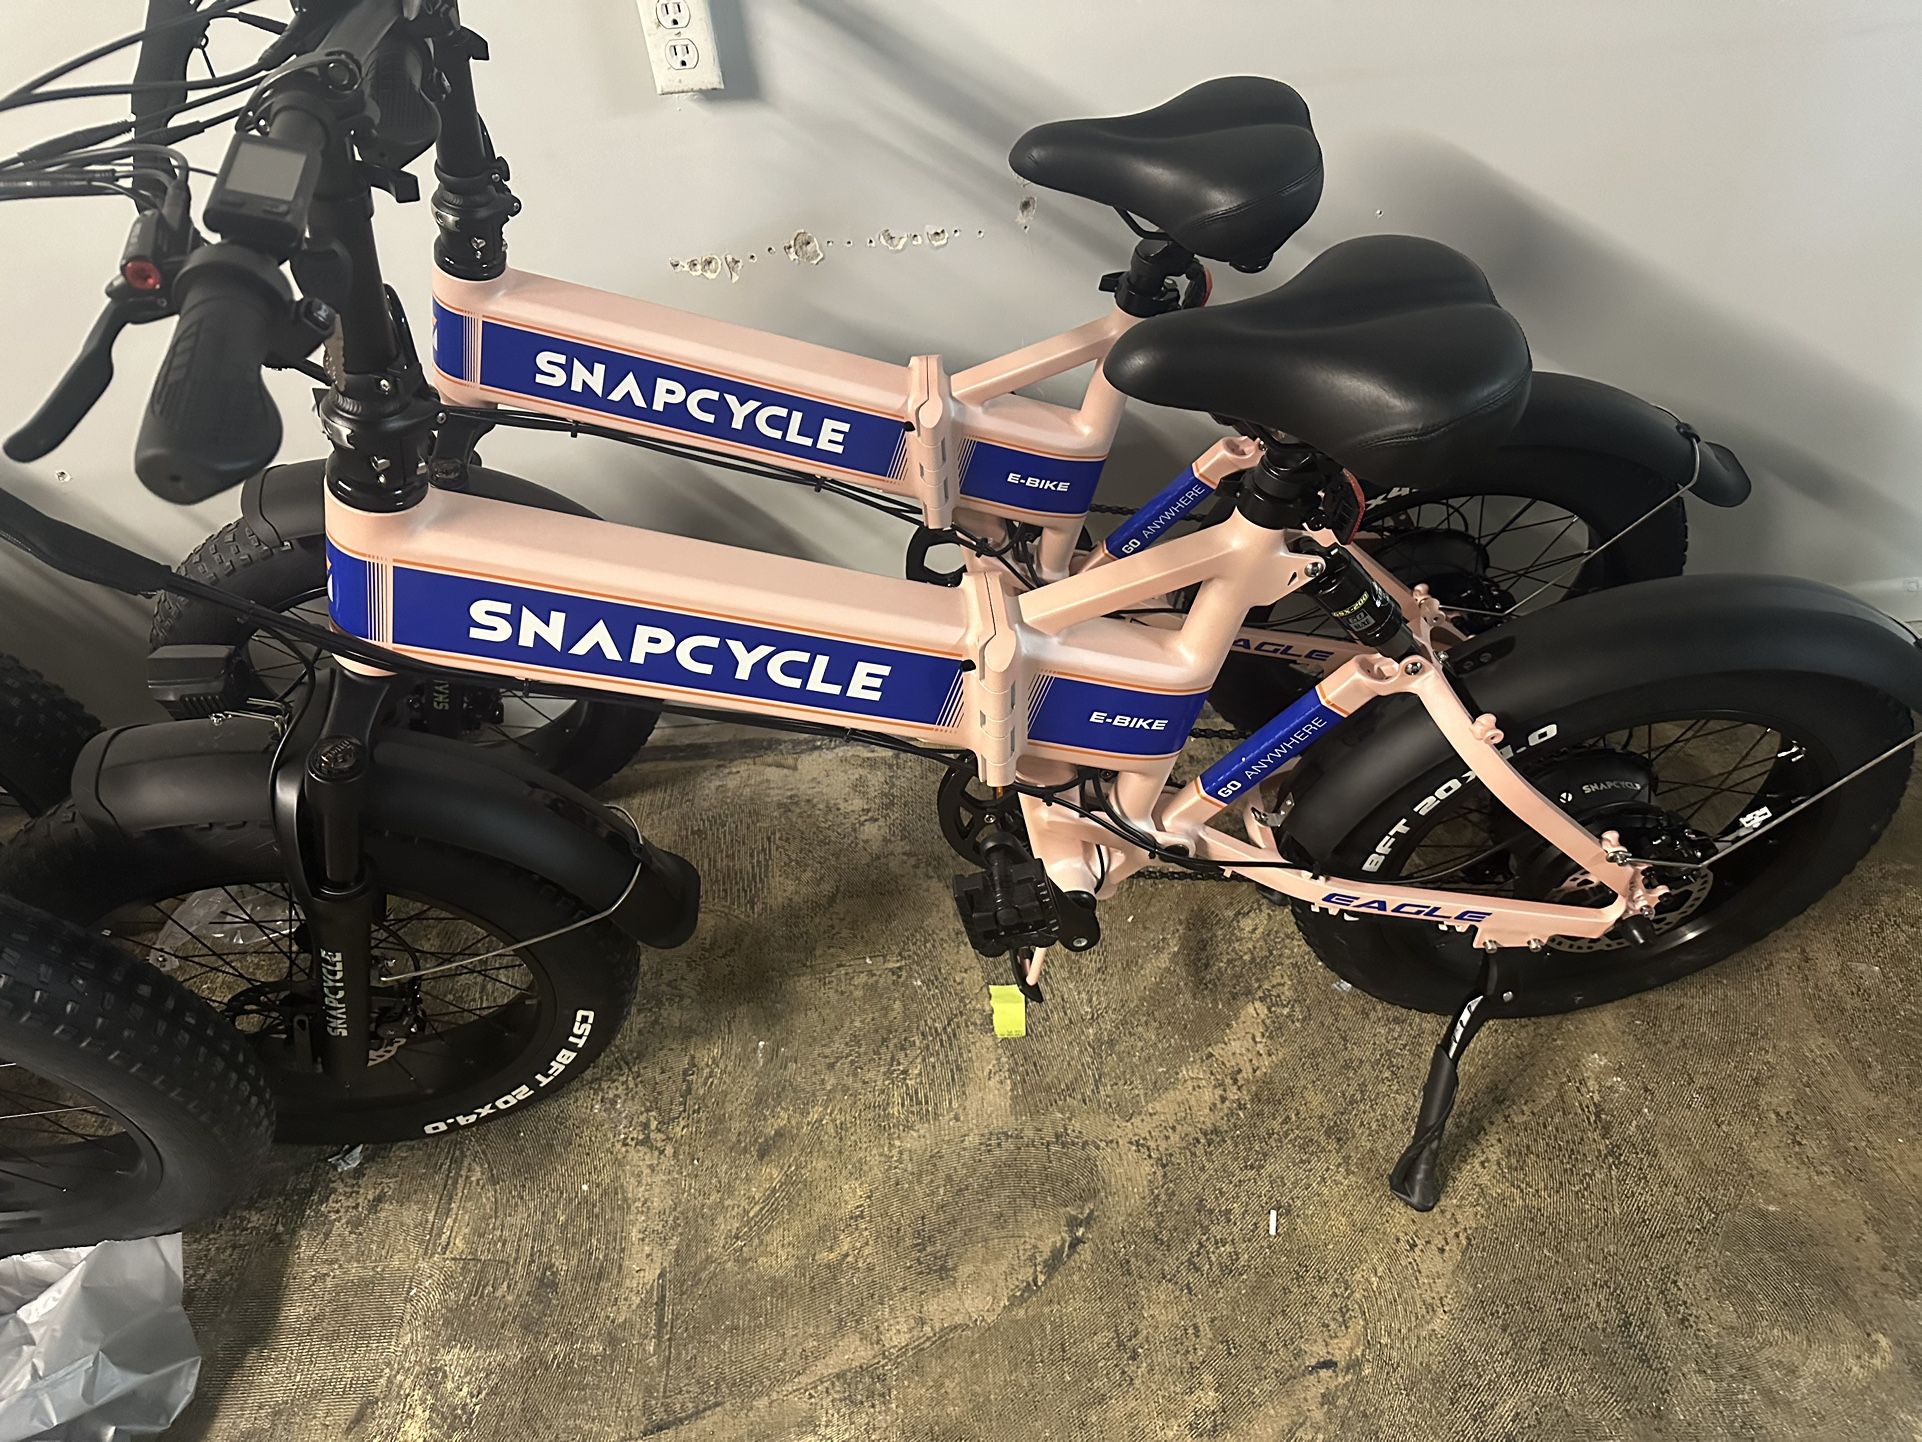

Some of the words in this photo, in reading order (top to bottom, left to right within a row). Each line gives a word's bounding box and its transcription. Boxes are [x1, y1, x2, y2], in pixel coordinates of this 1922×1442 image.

[535, 351, 851, 454] SNAPCYCLE
[1007, 472, 1070, 492] E-BIKE
[1121, 538, 1141, 554] GO
[1142, 484, 1205, 539] ANYWHERE
[469, 599, 892, 701] SNAPCYCLE
[1232, 638, 1335, 661] AGLE
[1089, 711, 1169, 730] E-BIKE
[1217, 780, 1242, 798] GO
[1244, 716, 1328, 780] ANYWHERE
[1361, 818, 1411, 872] BFT
[1322, 892, 1493, 923] EAGLE
[567, 1009, 595, 1048] CST
[534, 1047, 578, 1088] BFT
